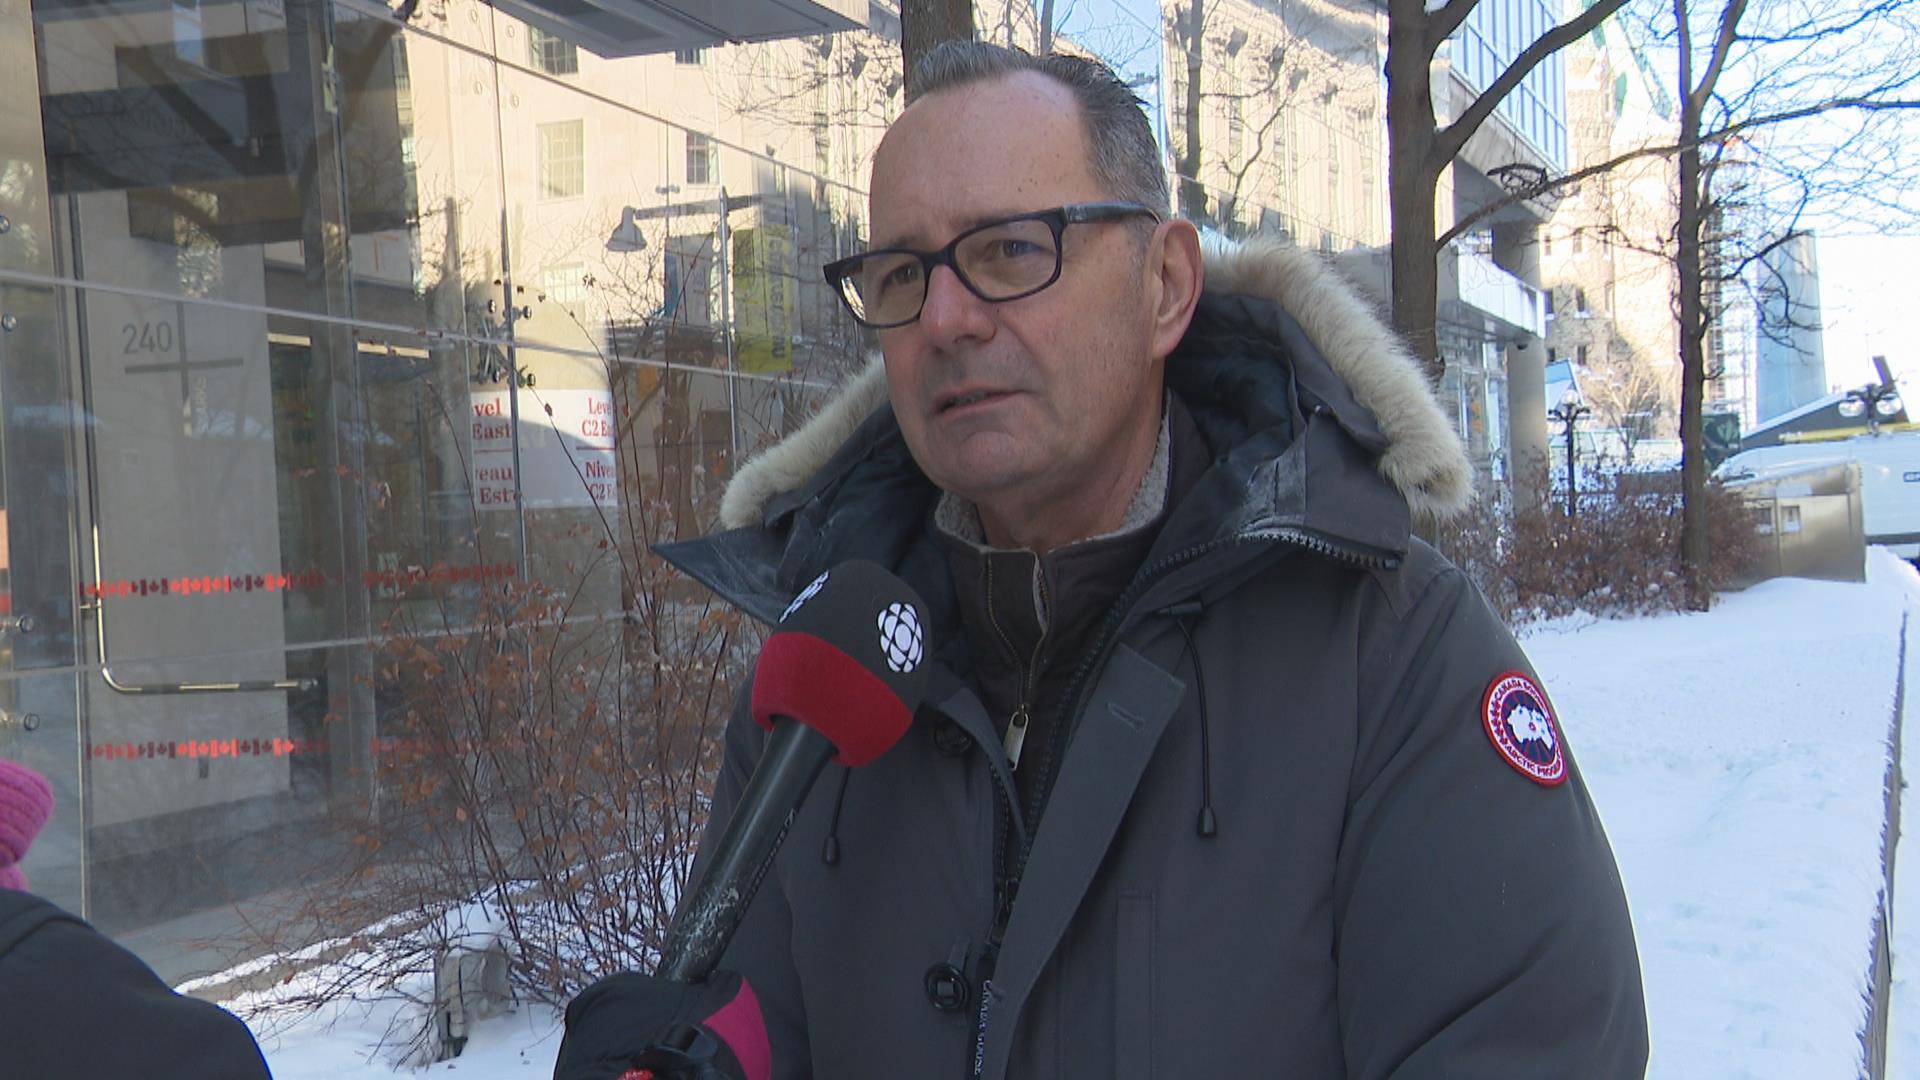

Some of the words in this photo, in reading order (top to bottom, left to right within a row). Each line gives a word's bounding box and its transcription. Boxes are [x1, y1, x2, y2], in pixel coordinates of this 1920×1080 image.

[122, 322, 172, 354] 240
[473, 422, 512, 440] East
[582, 419, 599, 437] C2
[1504, 745, 1536, 774] ARCTIC
